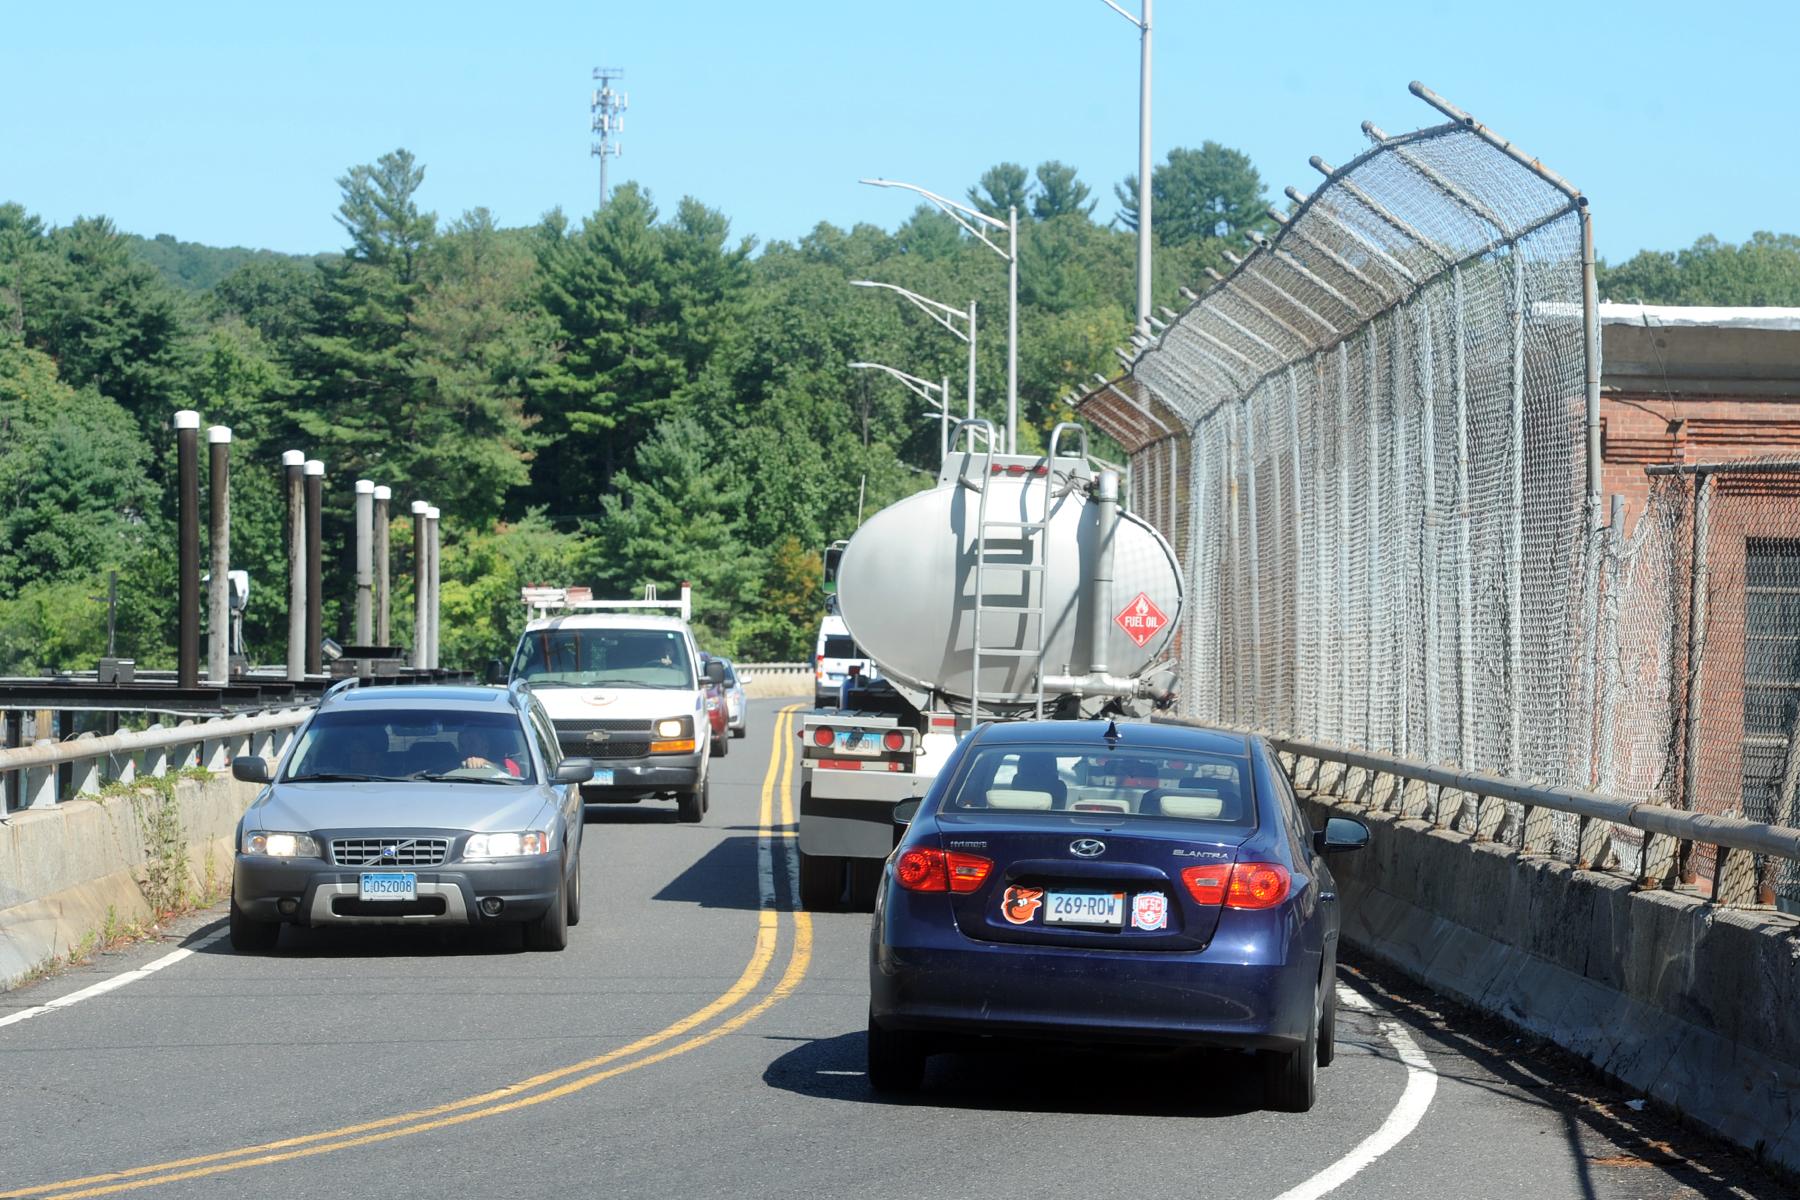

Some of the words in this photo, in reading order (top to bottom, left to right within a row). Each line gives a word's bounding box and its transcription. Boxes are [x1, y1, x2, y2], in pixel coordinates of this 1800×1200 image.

[1124, 615, 1144, 628] FUEL
[1146, 616, 1159, 628] OIL
[1138, 634, 1144, 643] 3
[1172, 849, 1228, 861] ELANTRA
